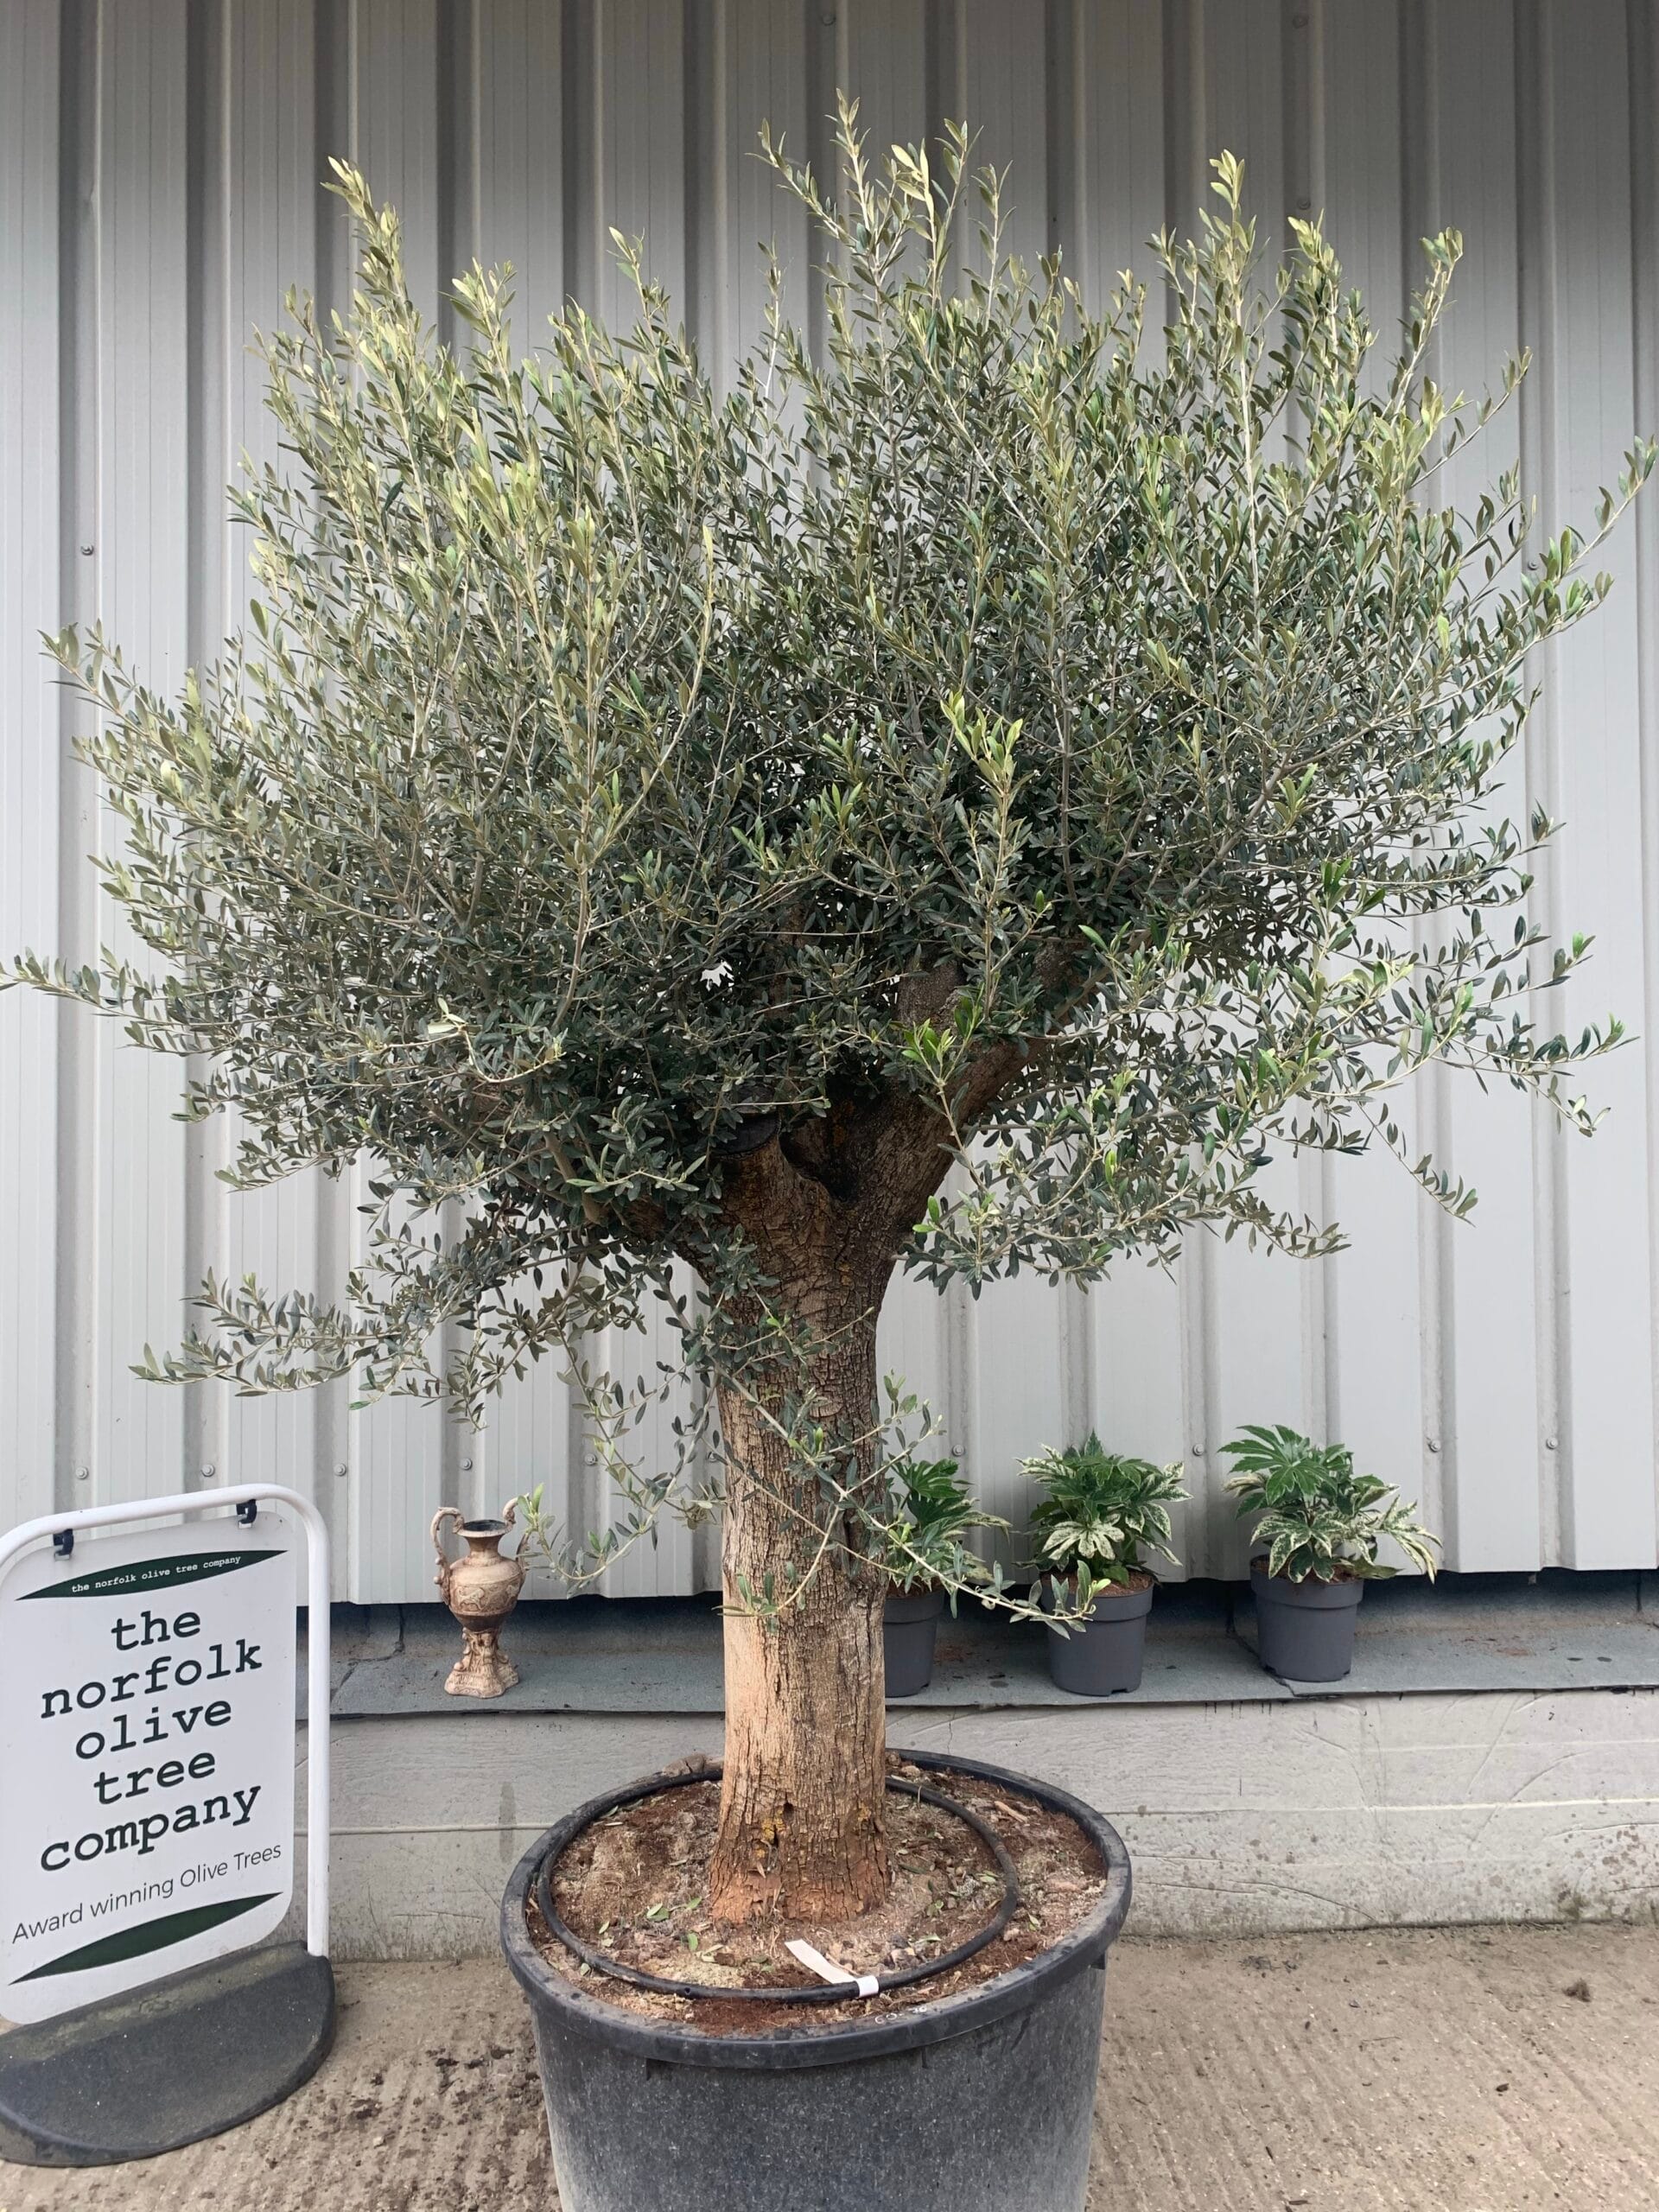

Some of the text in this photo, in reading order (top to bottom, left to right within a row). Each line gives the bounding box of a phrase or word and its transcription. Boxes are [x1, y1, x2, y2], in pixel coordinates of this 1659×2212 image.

[71, 1555, 242, 1593] the norfolk olive tree company
[111, 1610, 201, 1651] the
[41, 1638, 263, 1719] norfolk
[75, 1700, 232, 1760] olive
[93, 1752, 216, 1805] tree
[40, 1785, 262, 1872] company
[11, 1844, 282, 1944] Award winning Olive Trees
